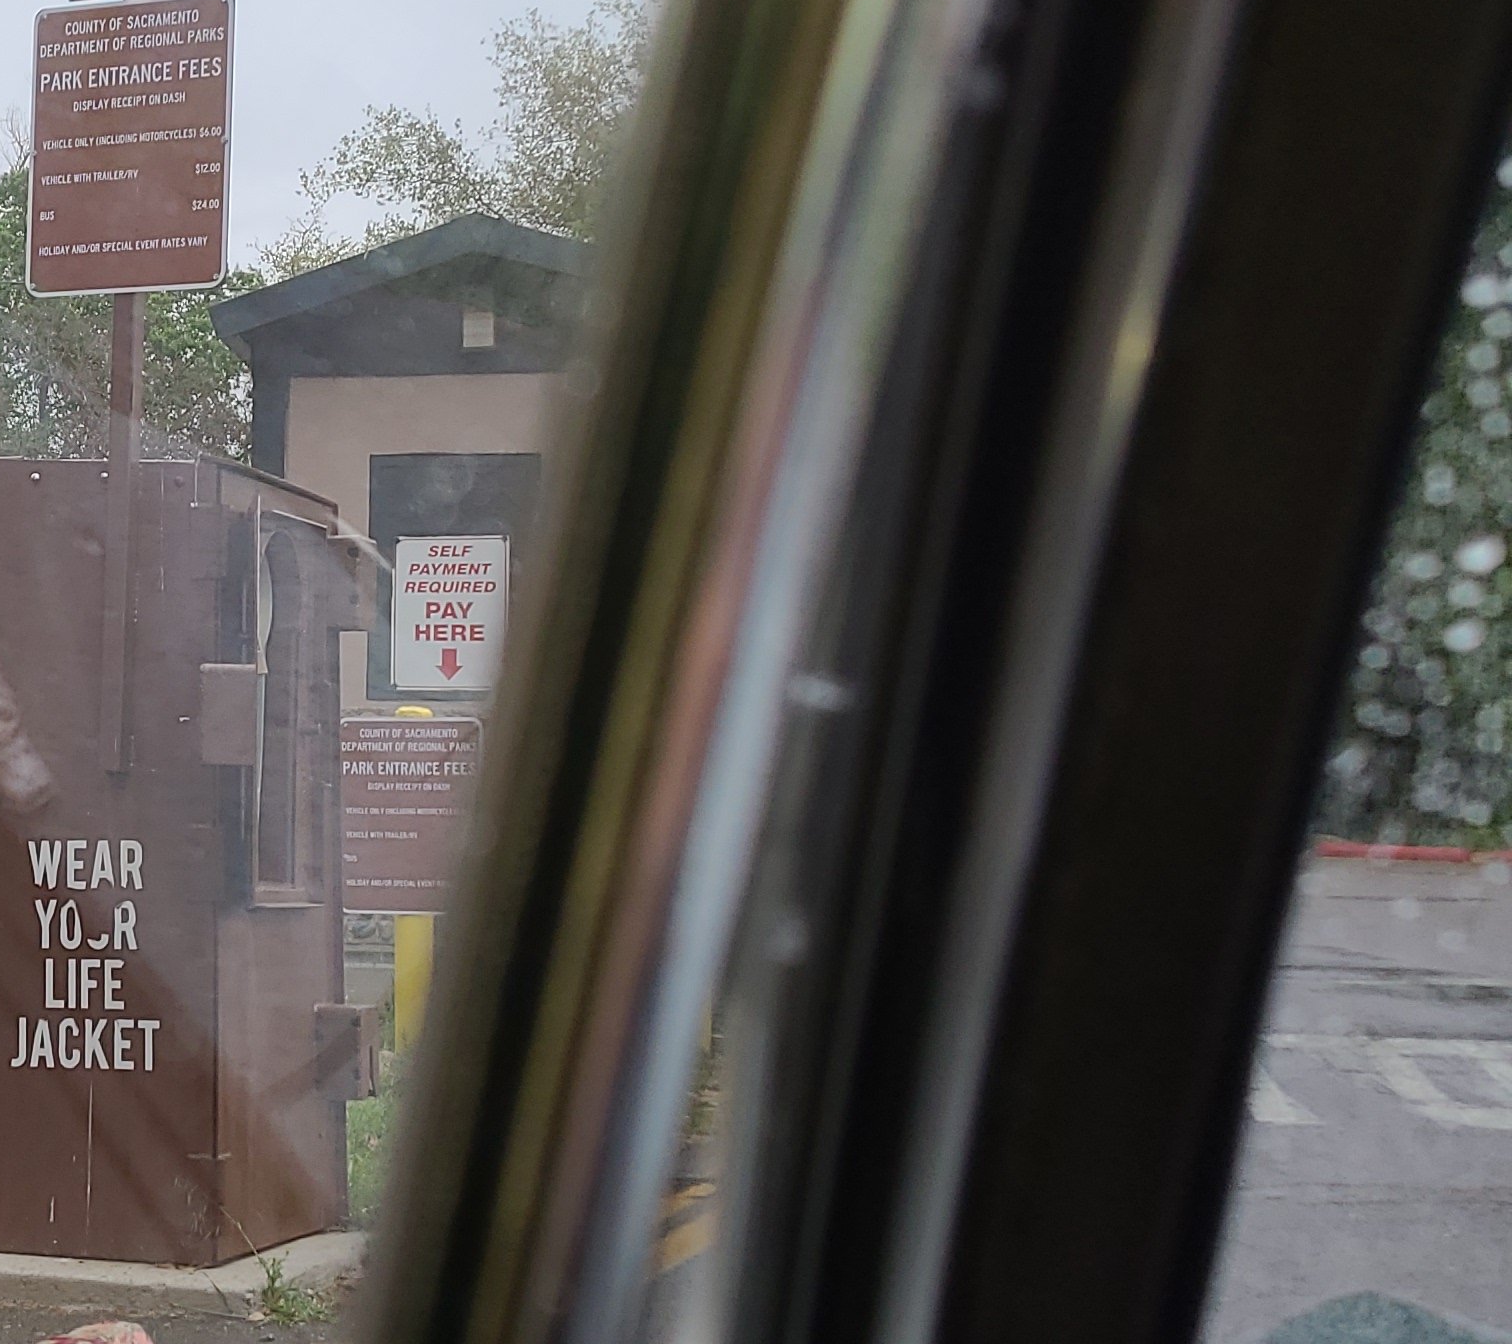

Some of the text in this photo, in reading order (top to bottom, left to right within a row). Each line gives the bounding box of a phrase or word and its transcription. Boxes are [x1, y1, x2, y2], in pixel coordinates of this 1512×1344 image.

[65, 9, 199, 36] COUNTY OF SACRAMENTO
[40, 27, 224, 58] DEPARTMENT OF REGIONAL PARKS
[40, 57, 222, 93] PARK ENTRANCE FEES
[73, 91, 186, 112] DISPLAY RECEIPT ON DASH
[42, 138, 73, 151] VEHICLE
[74, 136, 94, 148] ONLY
[95, 132, 138, 147] (INCLUDING
[199, 126, 222, 138] $6.00
[41, 162, 220, 187] VEHICLE WITH TRAILER/RV $12.00
[39, 198, 220, 221] BUS $24.00
[38, 235, 208, 257] HOLIDAY AND/OR SPECIAL EVENT RATES VARY
[428, 545, 473, 557] SELF
[409, 563, 492, 575] PAYMENT
[404, 581, 497, 593] REQUIRED
[425, 602, 474, 619] PAY
[415, 624, 485, 642] HERE
[359, 728, 458, 739] COUNTY OF SACRAMENTO
[341, 741, 393, 752] DEPARTMENT
[395, 741, 406, 752] OF
[407, 741, 447, 752] REGIONAL
[342, 761, 374, 775] PARK
[378, 761, 440, 776] ENTRANCE
[28, 839, 144, 890] WEAR
[45, 958, 125, 1010] LIFE
[10, 1016, 161, 1071] JACKET
